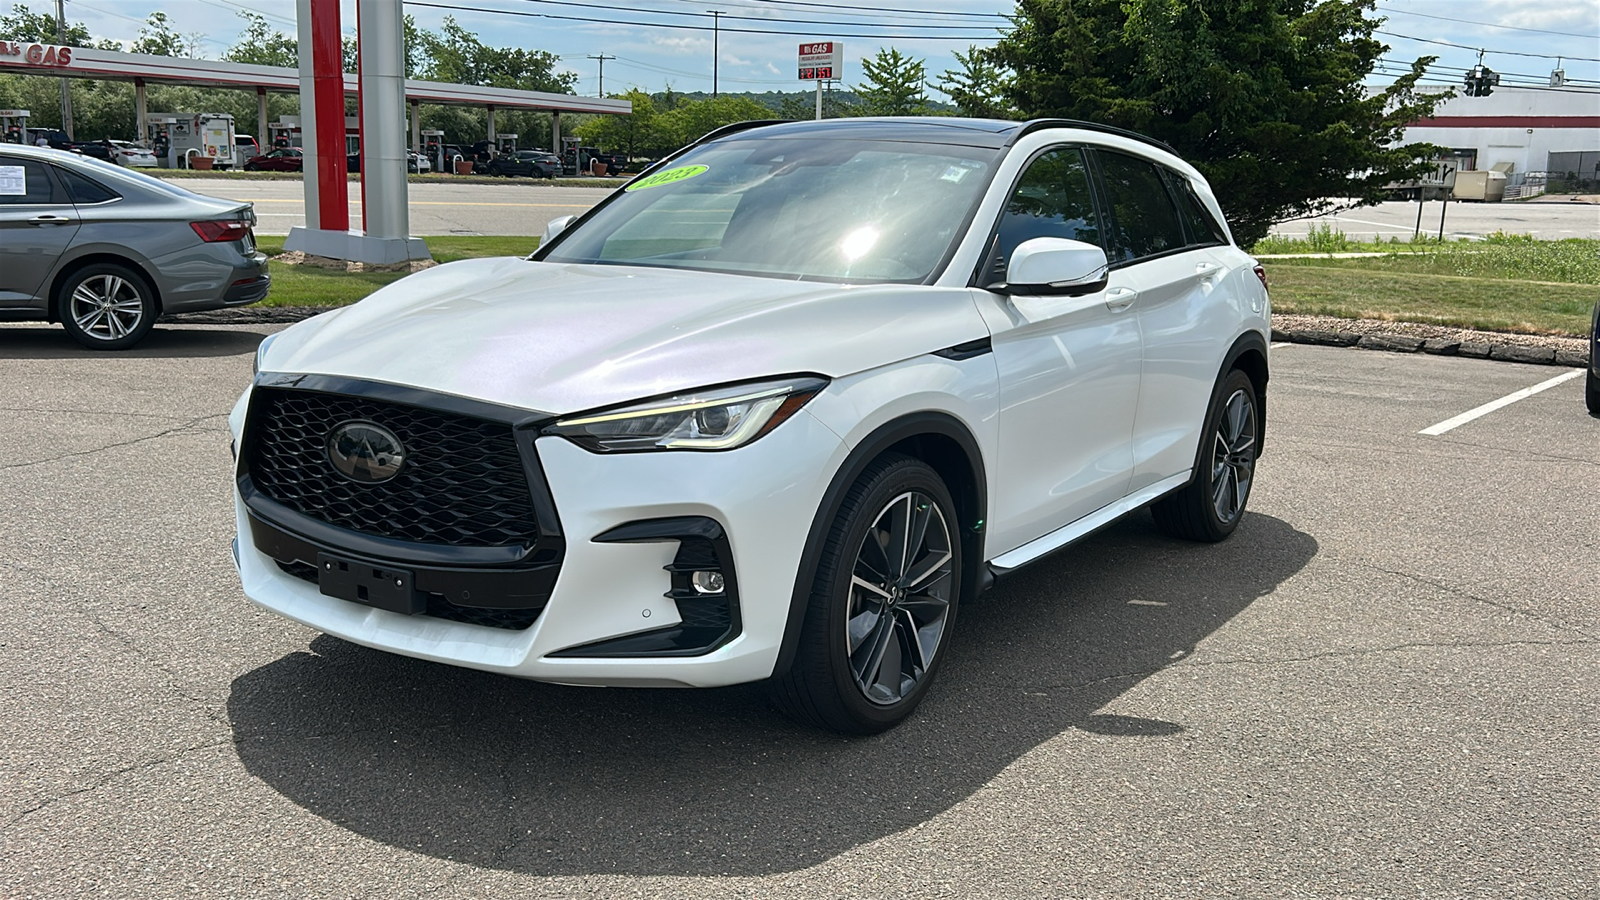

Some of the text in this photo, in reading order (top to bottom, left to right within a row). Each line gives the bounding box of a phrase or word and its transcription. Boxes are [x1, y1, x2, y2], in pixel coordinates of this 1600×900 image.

[27, 44, 72, 66] GAS
[812, 44, 828, 54] GAS
[635, 167, 698, 188] 2023
